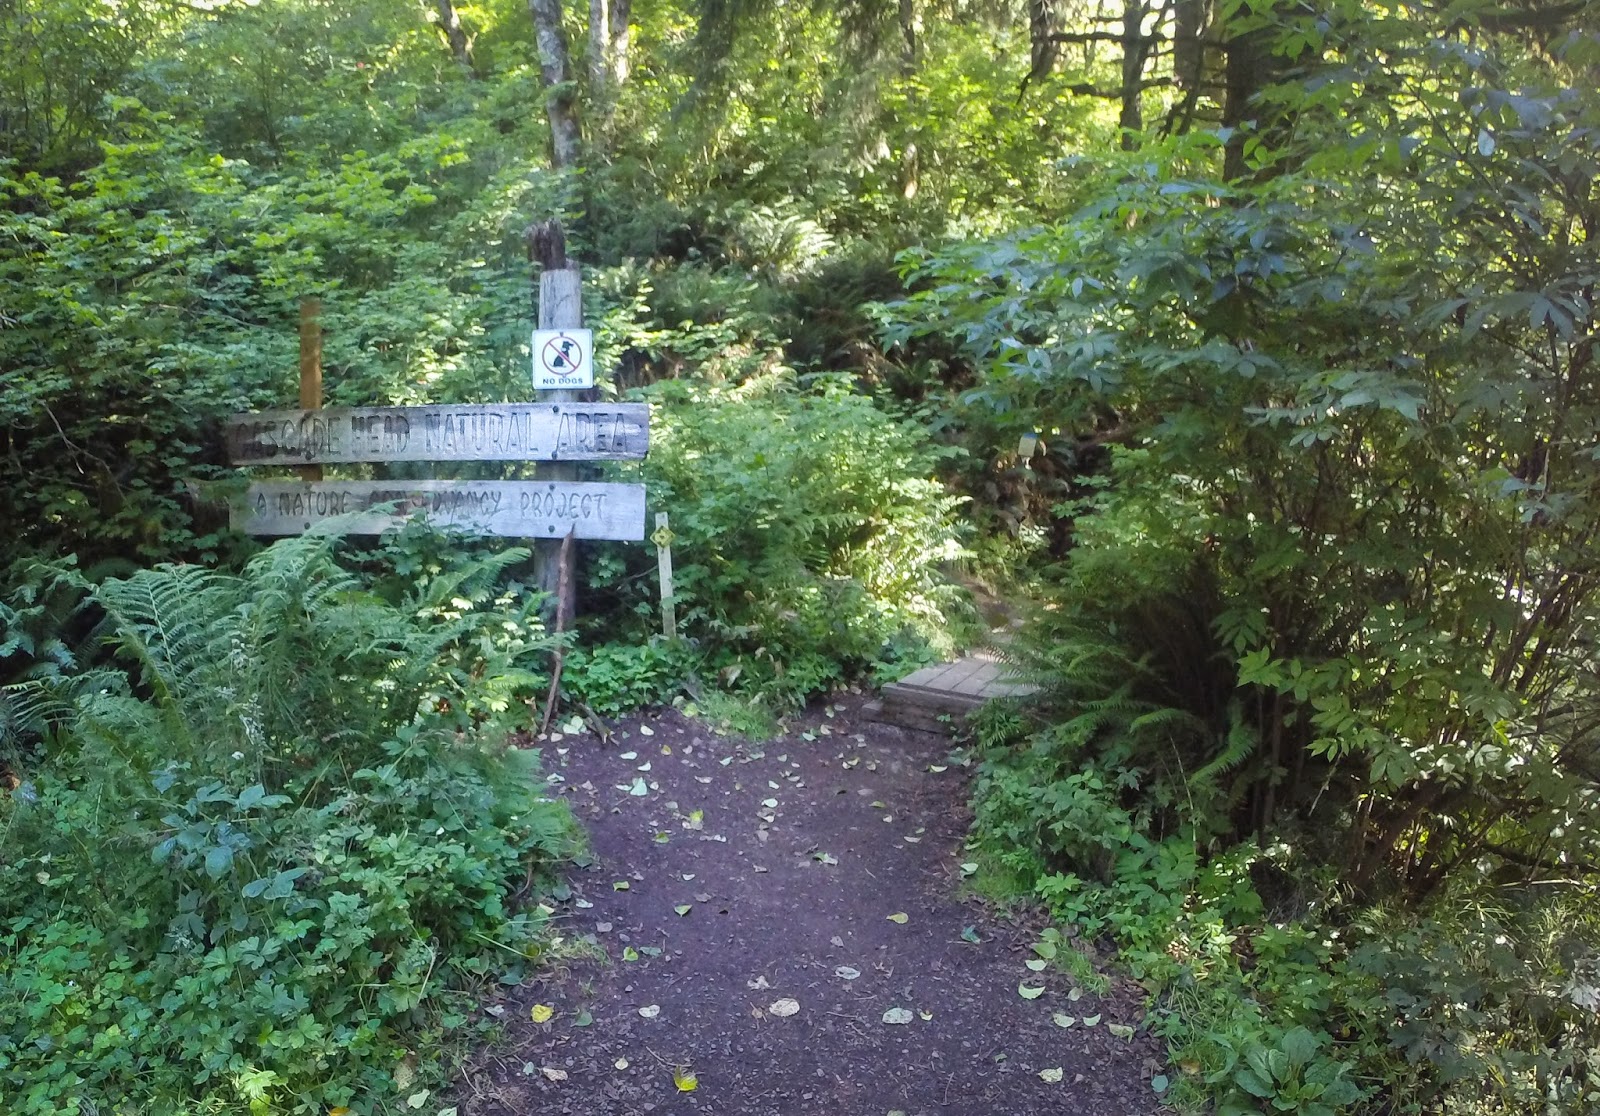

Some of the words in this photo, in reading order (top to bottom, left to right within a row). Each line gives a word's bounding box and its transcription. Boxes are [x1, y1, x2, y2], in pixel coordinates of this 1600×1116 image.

[351, 414, 411, 454] HEAD
[424, 412, 539, 454] NATURAL
[556, 412, 629, 453] AREA
[257, 492, 268, 517] A
[279, 490, 352, 517] NATURE
[520, 491, 608, 520] PROJECT
